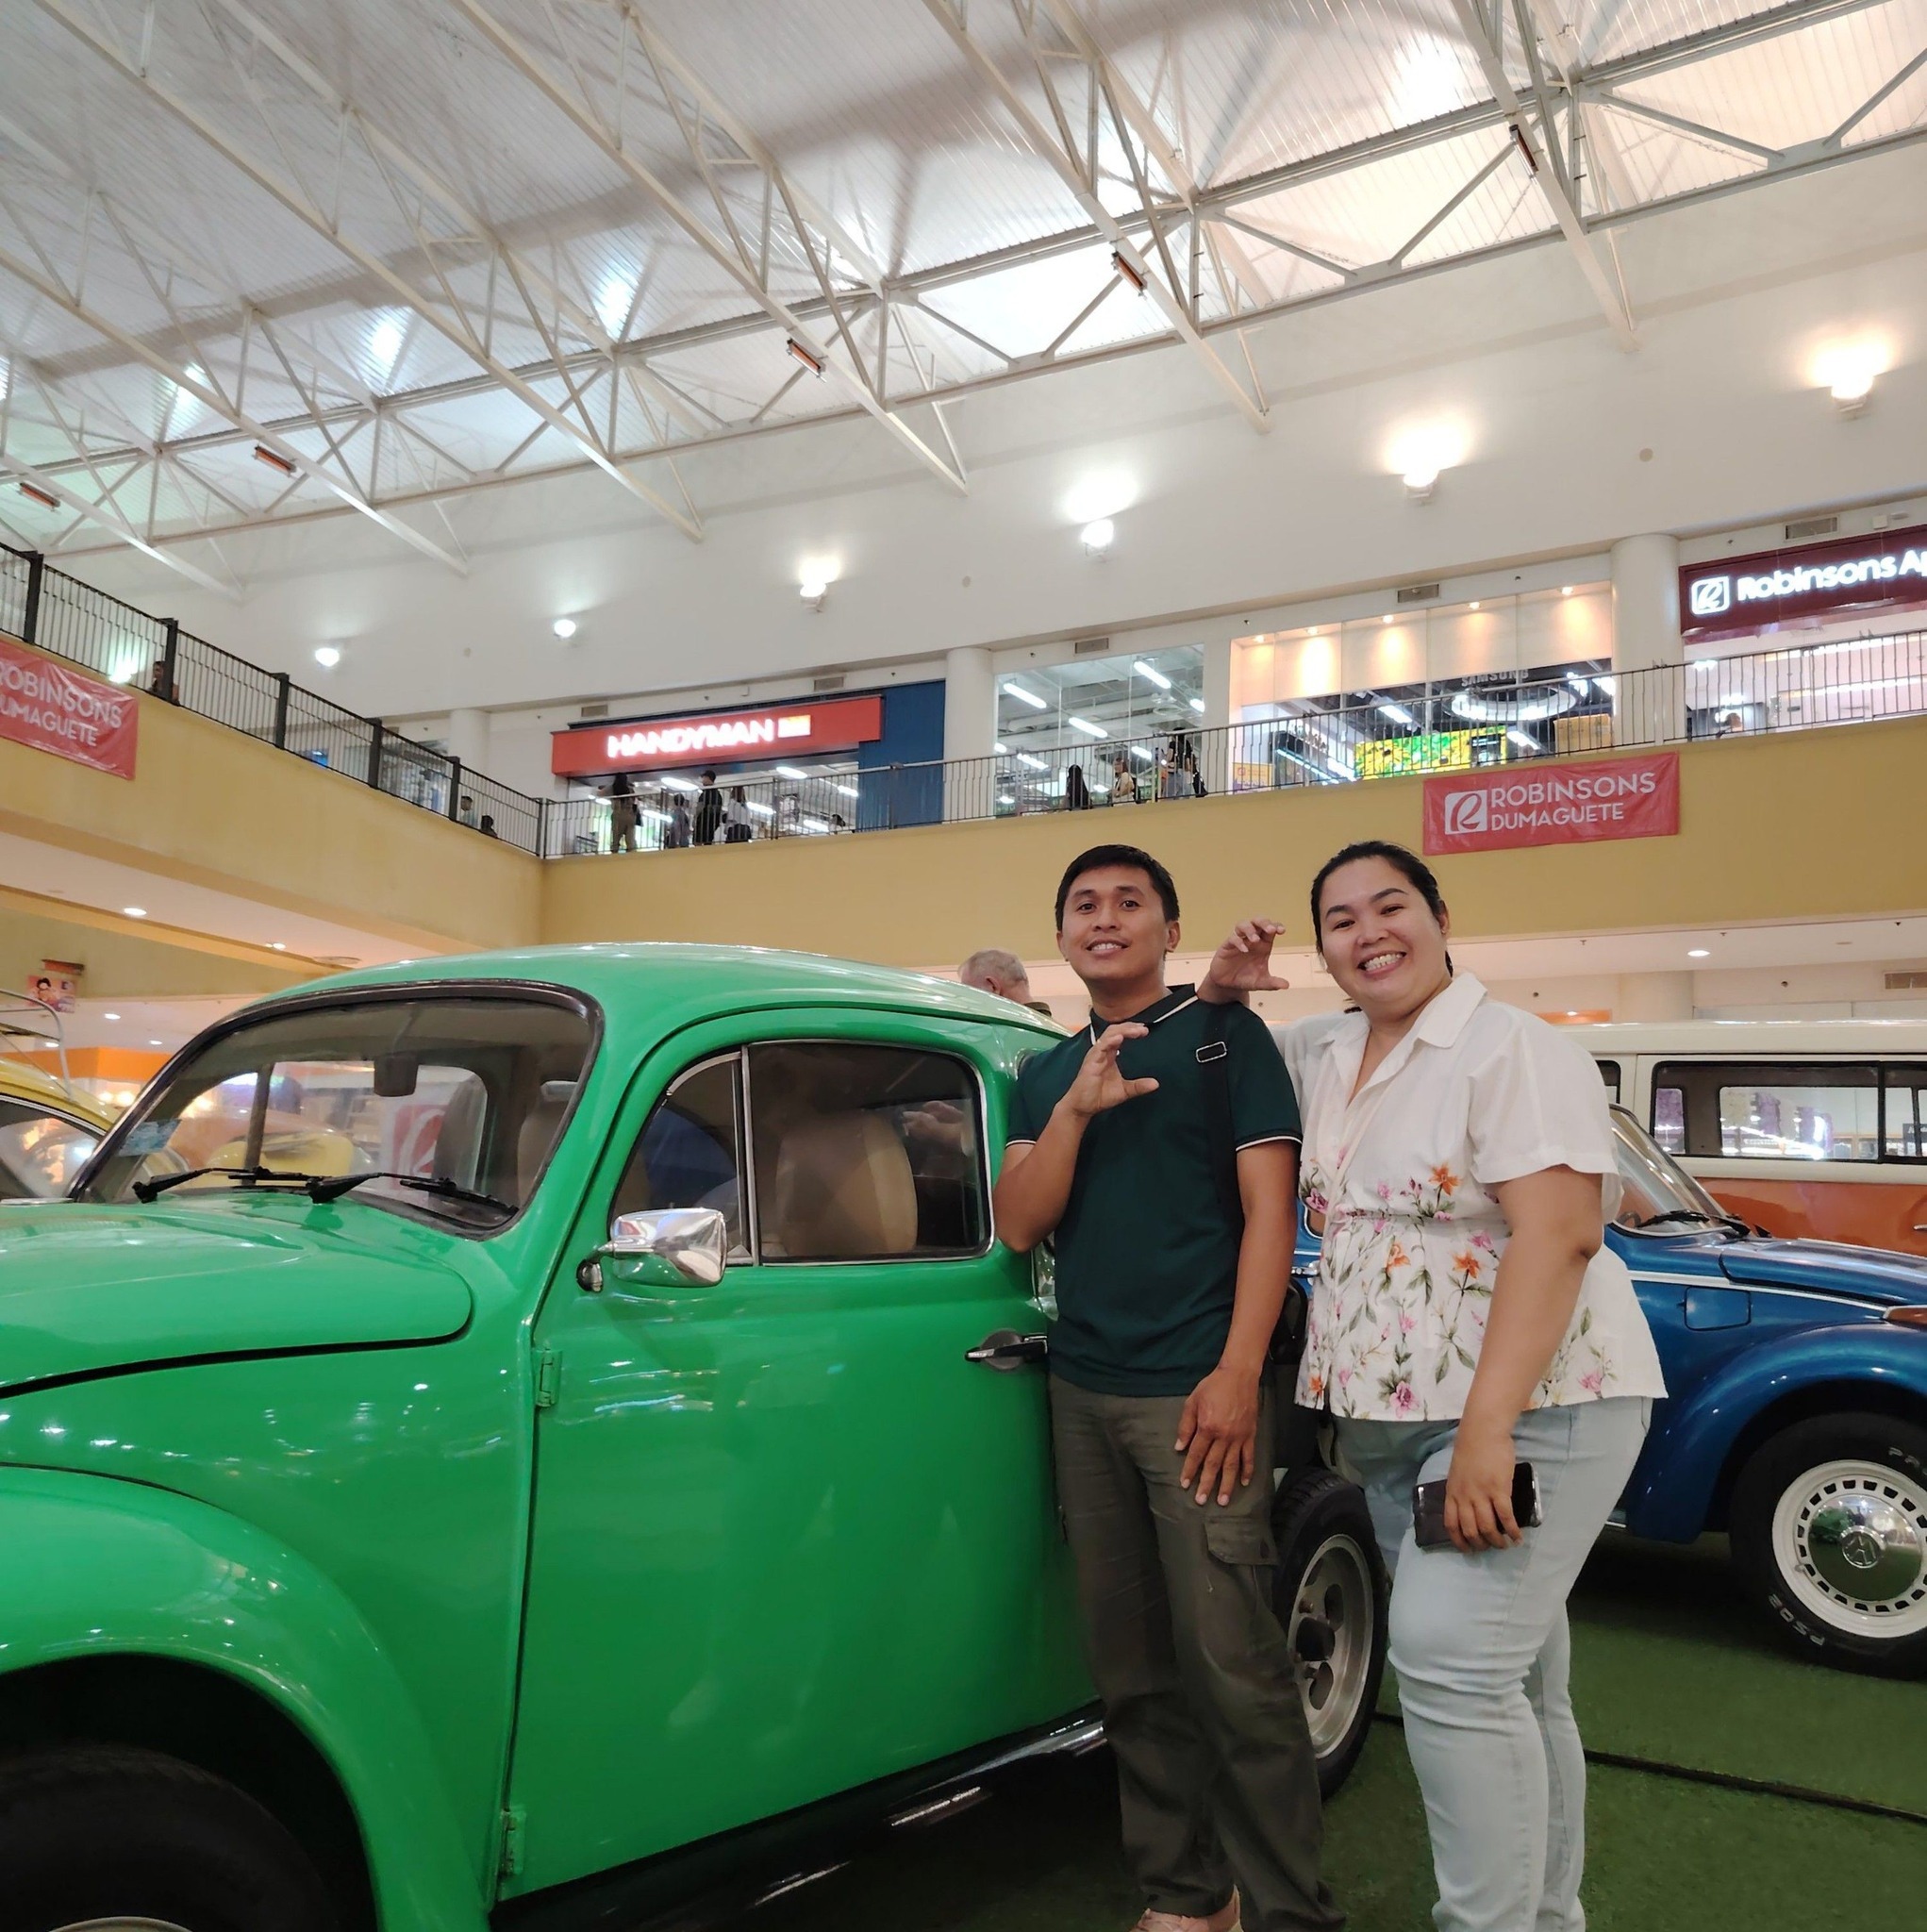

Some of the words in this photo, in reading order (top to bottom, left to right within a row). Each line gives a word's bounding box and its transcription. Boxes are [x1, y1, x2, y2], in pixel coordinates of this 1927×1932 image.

[1737, 555, 1897, 601] Robinsons
[607, 718, 774, 758] HANDYMAN
[1490, 772, 1656, 808] ROBINSONS
[1491, 802, 1624, 831] DUMAGUETE
